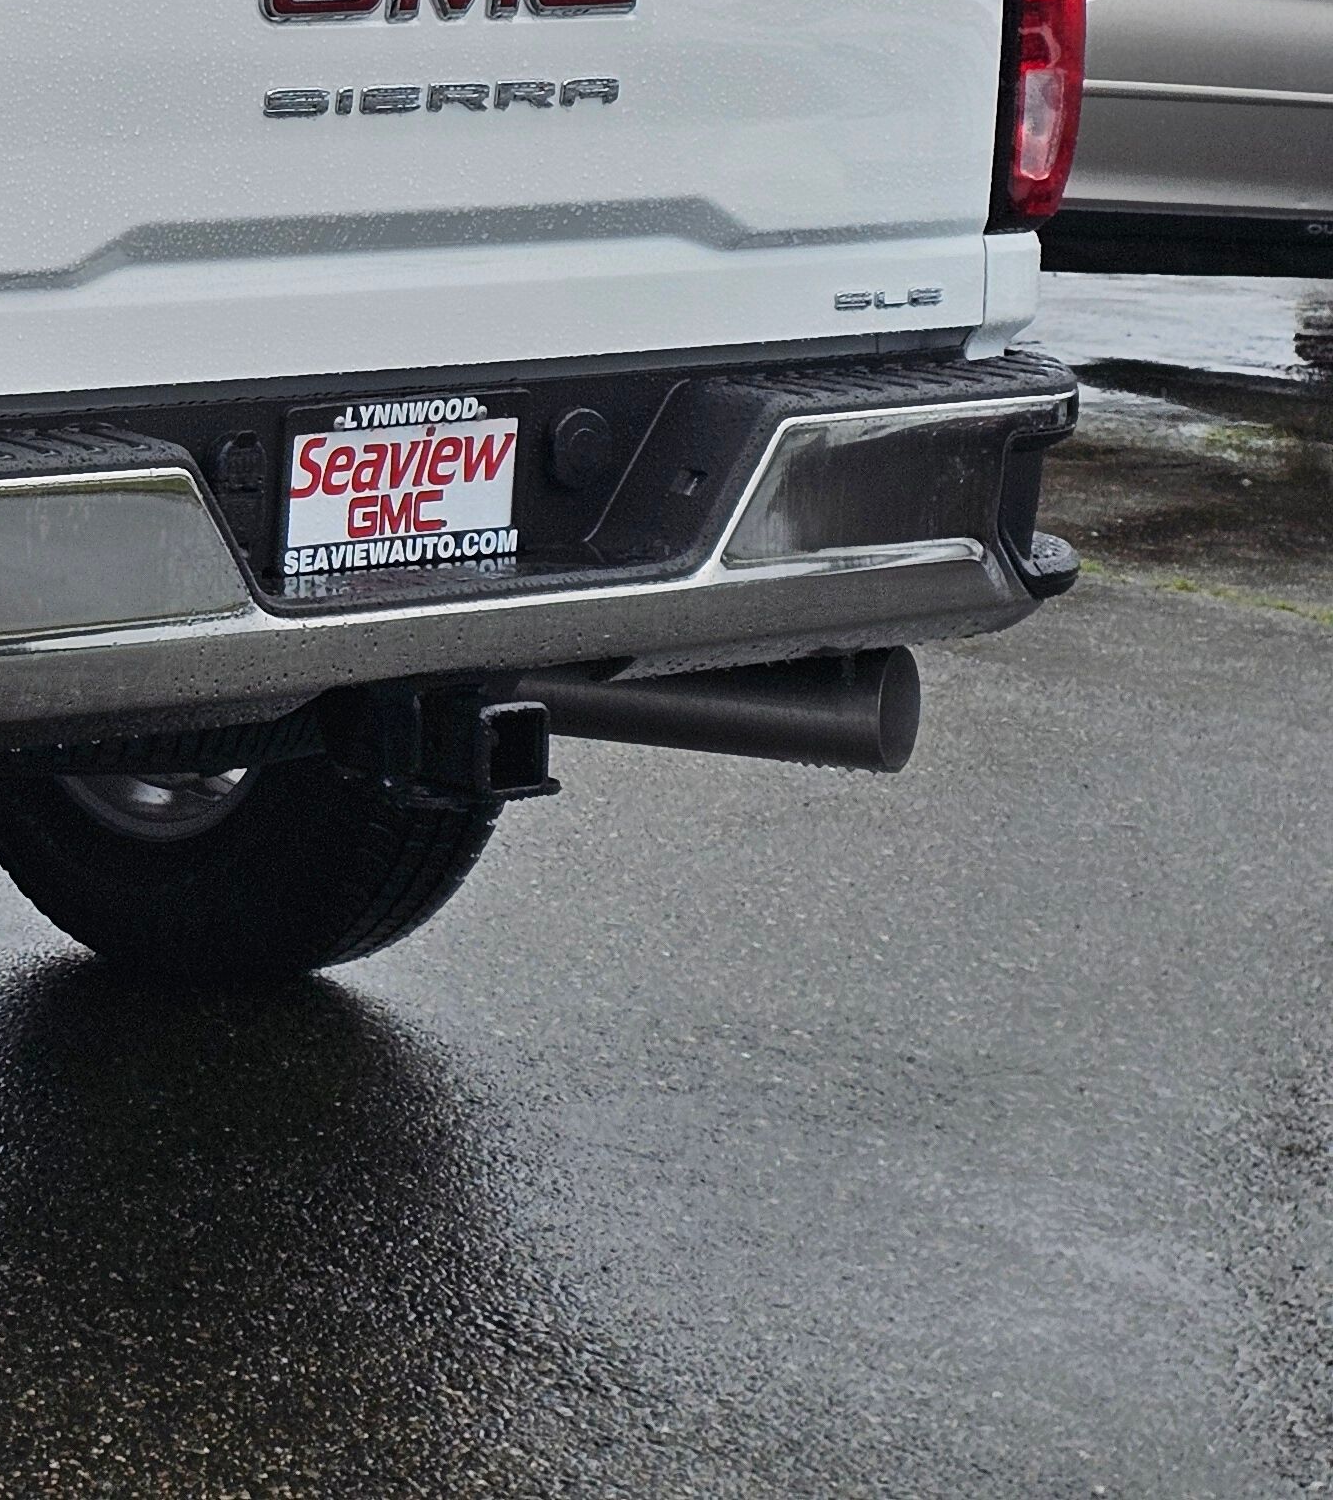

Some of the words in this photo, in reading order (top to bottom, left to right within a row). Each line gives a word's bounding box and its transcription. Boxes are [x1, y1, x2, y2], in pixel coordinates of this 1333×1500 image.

[262, 77, 621, 118] SIERRA
[834, 287, 944, 310] SLE
[343, 397, 479, 429] LYNNWOOD
[290, 426, 516, 499] Seaview
[347, 489, 447, 539] GMC
[283, 529, 519, 576] SEAVIEWAUTO.COM
